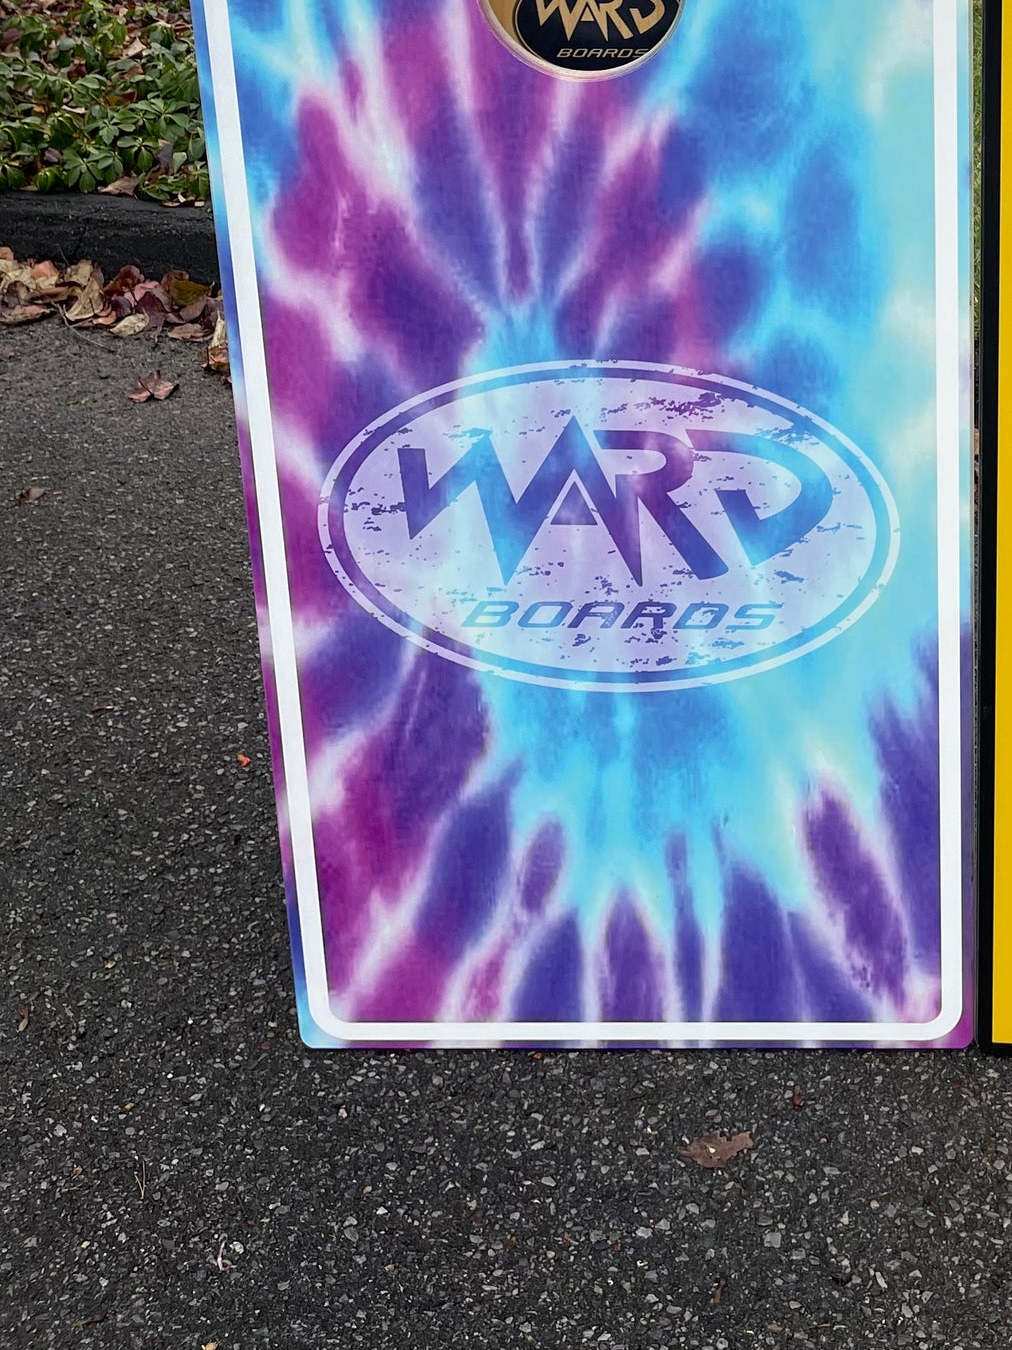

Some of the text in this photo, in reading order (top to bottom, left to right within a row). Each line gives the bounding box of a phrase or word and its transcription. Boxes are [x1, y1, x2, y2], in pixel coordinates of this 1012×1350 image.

[556, 47, 650, 59] BOARDS
[396, 414, 836, 588] WARD
[459, 599, 785, 632] BOARDS
